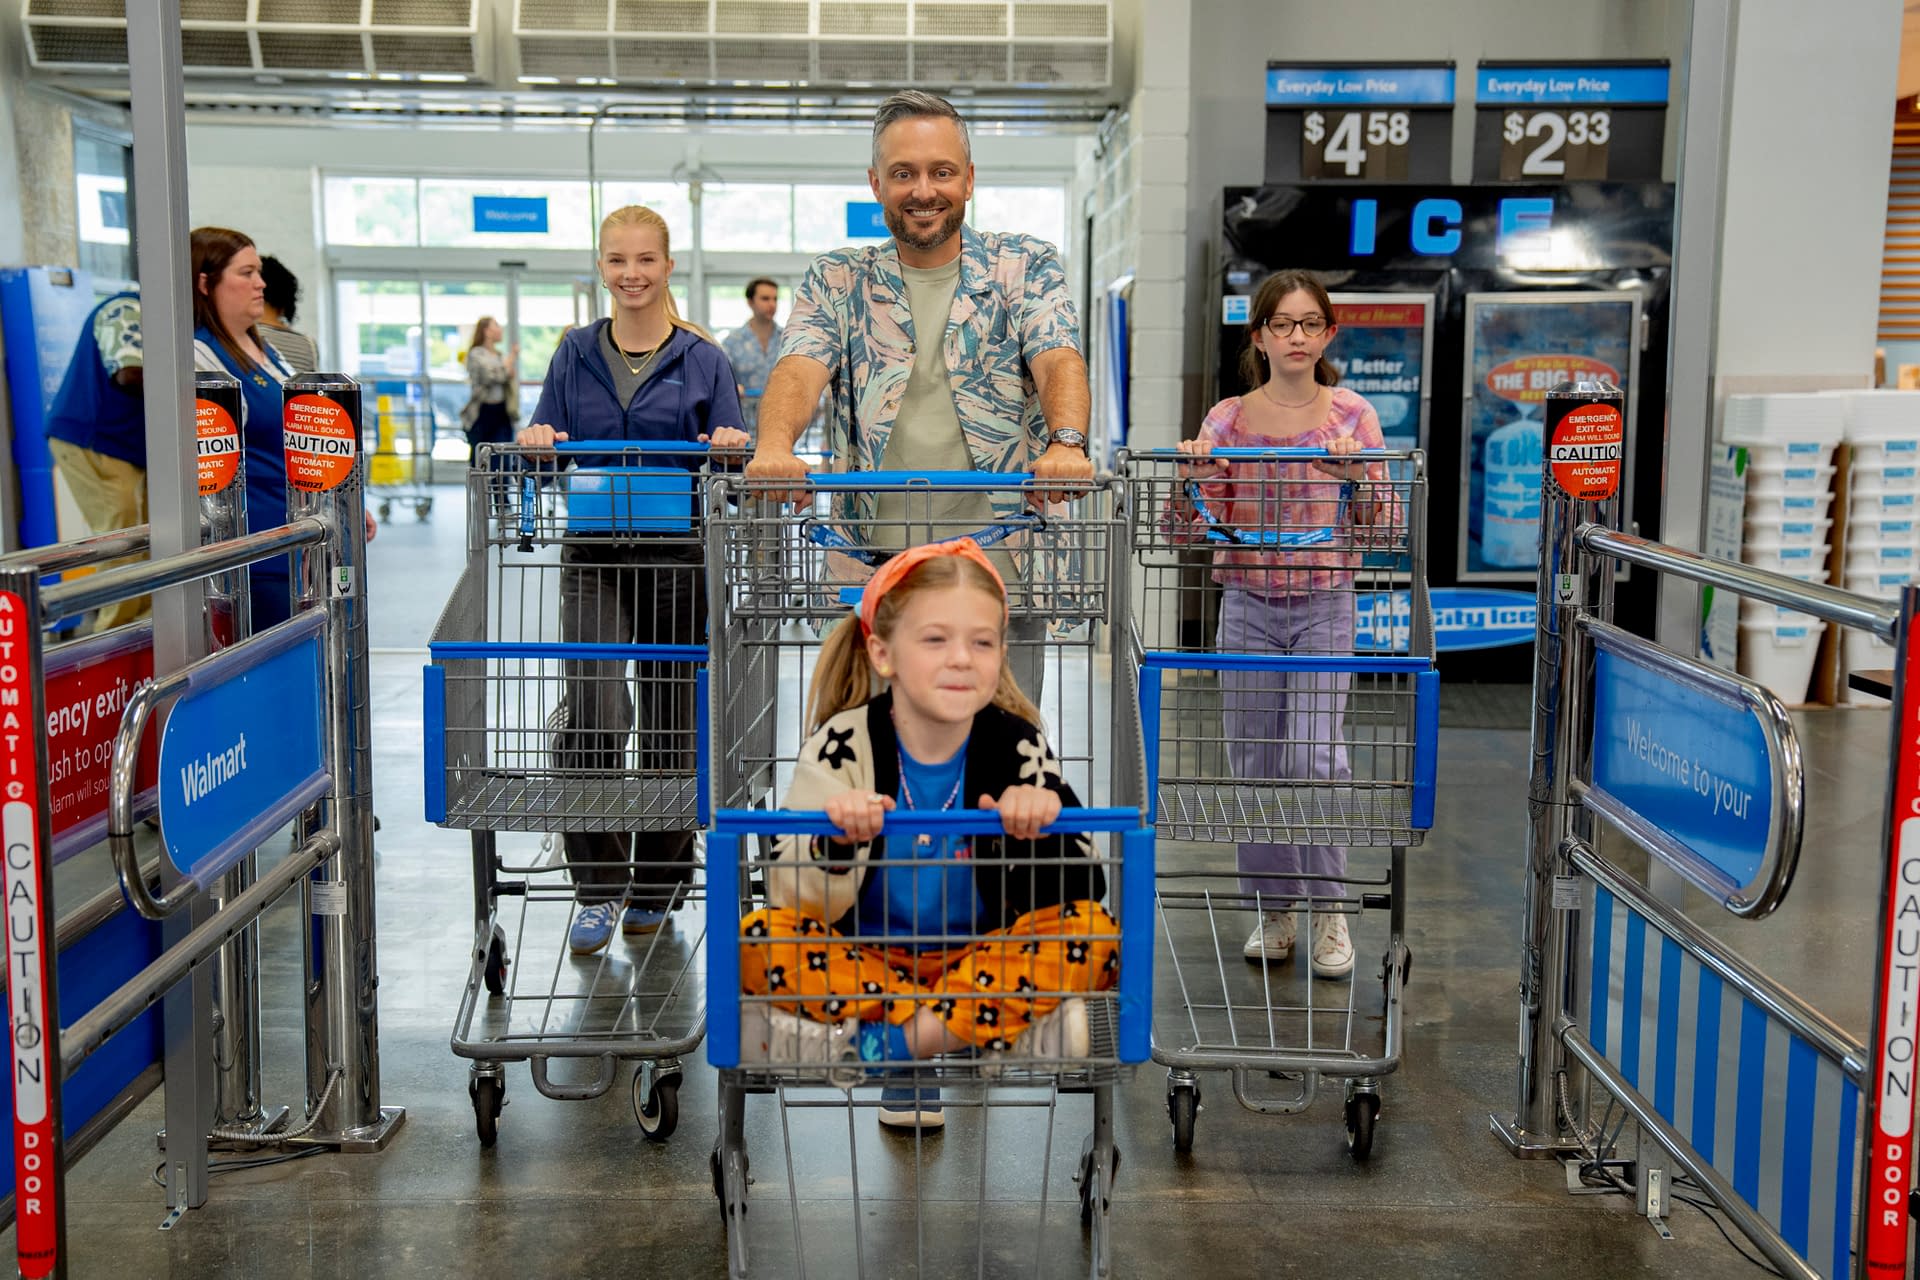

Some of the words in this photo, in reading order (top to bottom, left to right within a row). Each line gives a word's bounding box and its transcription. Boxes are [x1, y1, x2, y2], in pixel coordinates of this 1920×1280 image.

[1277, 79, 1335, 97] Everyday
[1337, 79, 1362, 93] Low
[1366, 79, 1398, 93] Price
[1488, 78, 1547, 96] Everyday
[1549, 78, 1575, 92] Low
[1578, 77, 1610, 92] Price
[1349, 198, 1554, 256] ICE
[1351, 358, 1404, 374] Better
[1493, 372, 1525, 391] THE
[1530, 369, 1568, 390] BIG
[290, 402, 341, 416] EMERGENCY
[294, 413, 312, 423] EXIT
[313, 416, 336, 425] ONLY
[1568, 414, 1618, 424] EMERGENCY
[202, 426, 228, 435] SOUND
[303, 424, 320, 432] WILL
[321, 426, 346, 435] SOUND
[1576, 425, 1595, 433] EXIT
[1597, 424, 1615, 432] ONLY
[1562, 434, 1586, 442] ALARM
[291, 456, 336, 469] AUTOMATIC
[1571, 466, 1616, 476] AUTOMATIC
[298, 467, 323, 477] DOOR
[1584, 476, 1608, 485] DOOR
[199, 483, 218, 491] nzl
[1491, 606, 1537, 626] Ice
[0, 595, 24, 799] AUTOMATIC
[95, 676, 128, 719] exit
[75, 746, 91, 773] to
[1627, 716, 1690, 785] Welcome
[1694, 757, 1711, 797] to
[1713, 776, 1753, 820] your
[181, 732, 247, 807] Walmart
[76, 779, 92, 802] will
[7, 843, 41, 1086] CAUTION
[1886, 858, 1920, 1097] CAUTION
[24, 1132, 42, 1215] DOOR
[1882, 1144, 1903, 1227] DOOR
